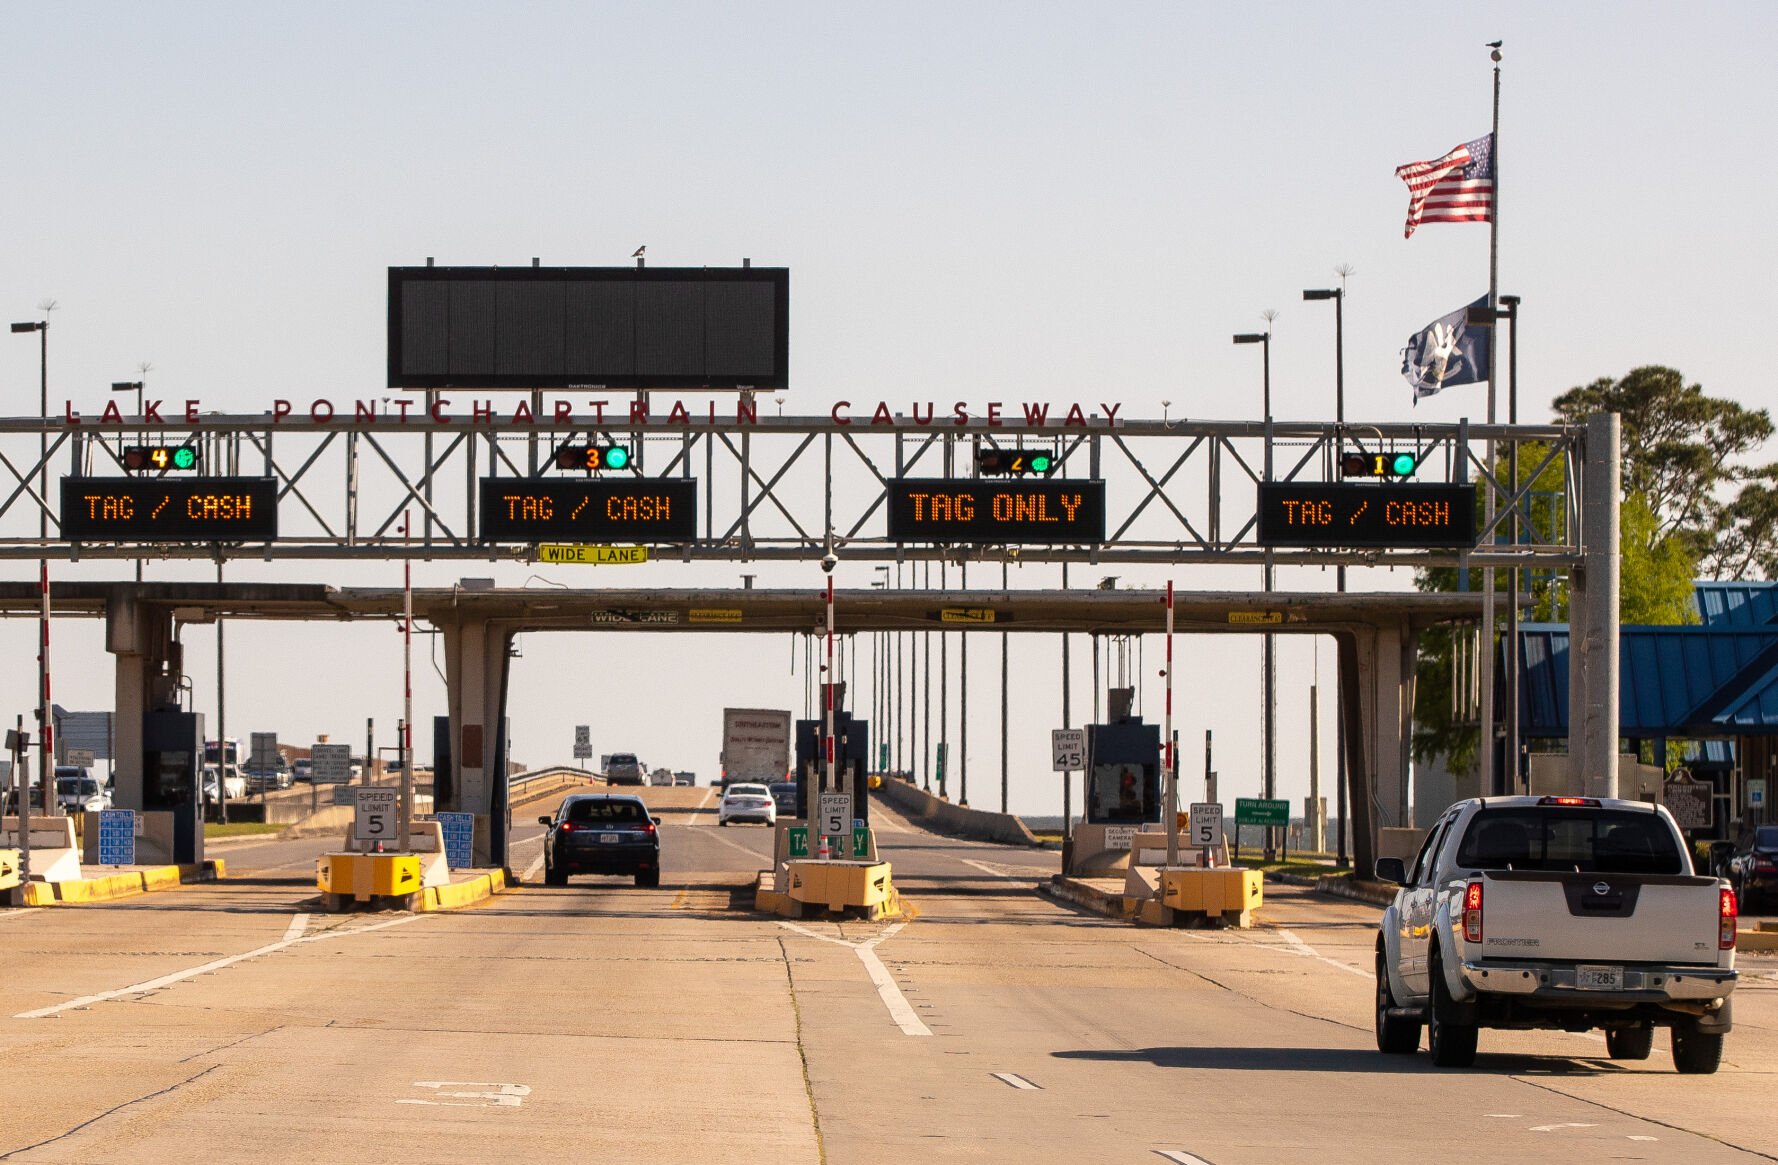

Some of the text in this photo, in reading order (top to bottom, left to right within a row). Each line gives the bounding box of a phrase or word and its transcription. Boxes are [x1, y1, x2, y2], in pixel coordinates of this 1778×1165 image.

[65, 399, 1122, 426] LAKE PONTCHARTRAIN CAUSEWAY
[151, 449, 169, 468] 4
[586, 449, 600, 468] 3
[1373, 455, 1384, 475] 1
[84, 495, 252, 520] TAG / CASH
[503, 495, 670, 520] TAG / CASH
[908, 493, 1082, 522] TAG ONLY
[1282, 500, 1449, 526] TAG / CASH
[548, 548, 639, 561] WIDE LANE
[1056, 753, 1081, 767] 45
[359, 792, 394, 802] SPEED
[1239, 801, 1287, 810] TURN AROUND
[362, 804, 390, 812] LIMIT
[1193, 807, 1221, 815] SPEED
[368, 815, 384, 834] 5
[830, 816, 842, 832] 5
[1195, 816, 1217, 824] LIMIT
[1200, 826, 1213, 842] 5
